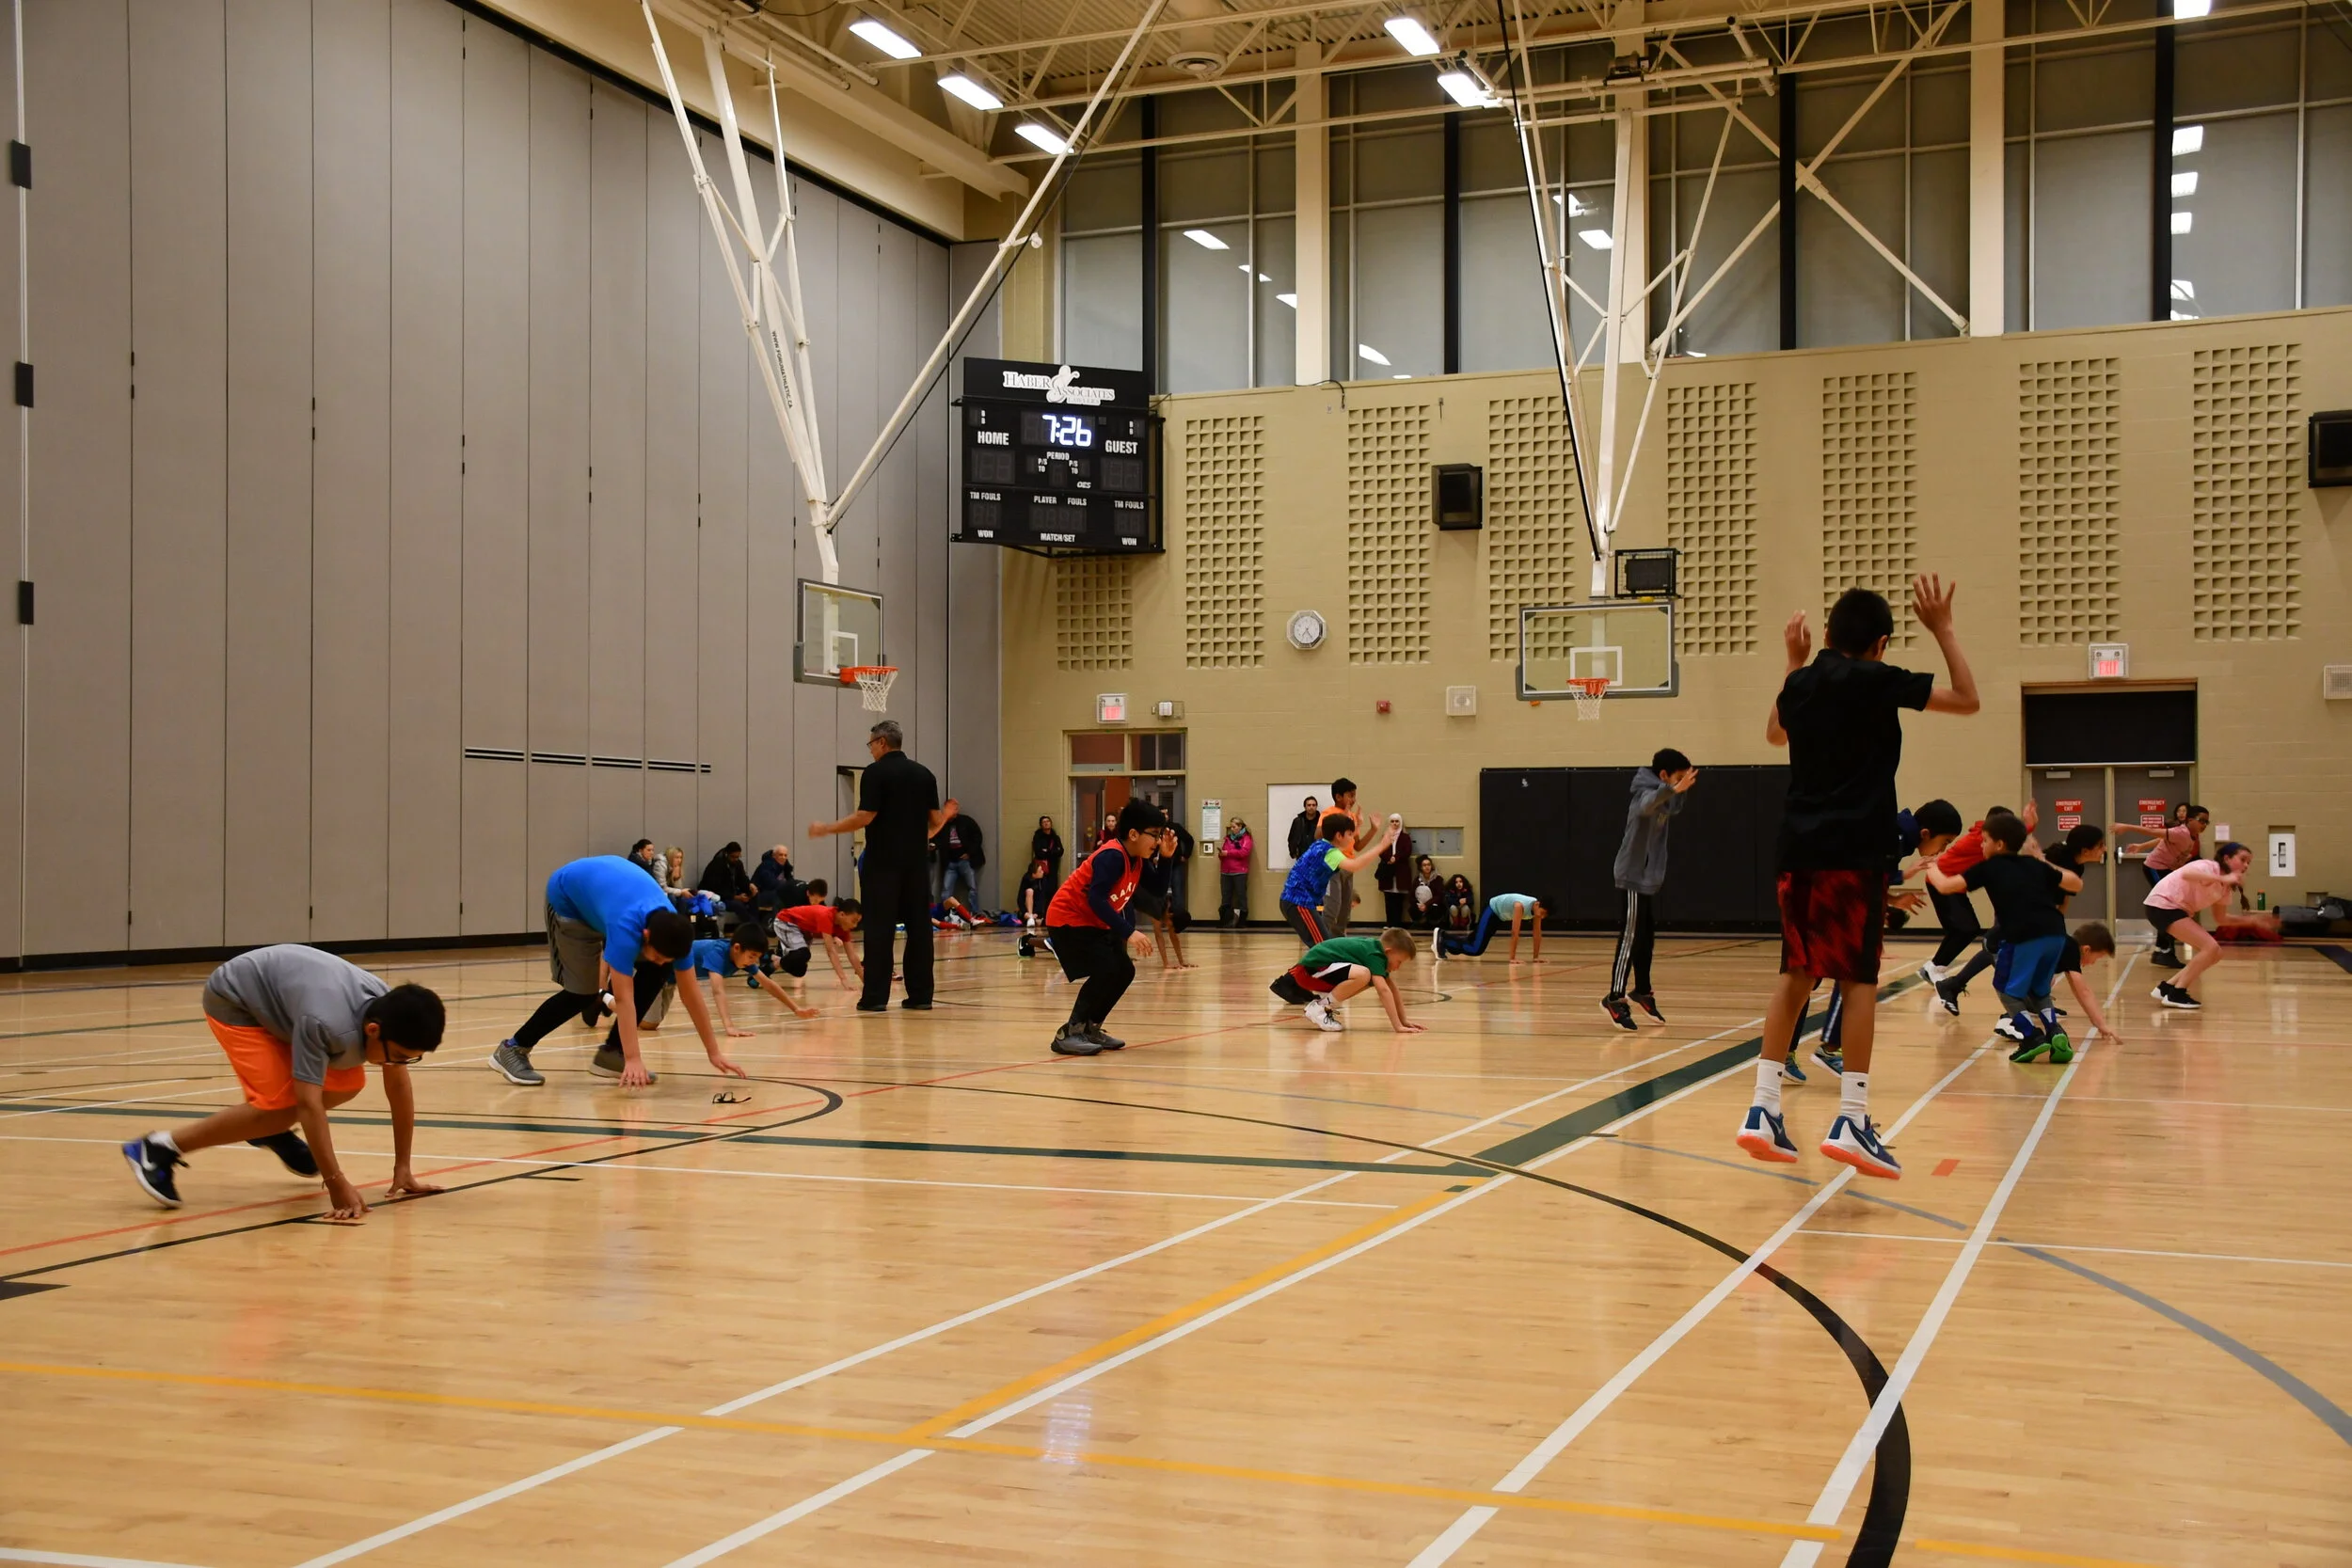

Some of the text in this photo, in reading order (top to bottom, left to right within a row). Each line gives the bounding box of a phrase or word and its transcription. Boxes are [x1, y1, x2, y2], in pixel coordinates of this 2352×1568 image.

[1005, 373, 1051, 388] HABER
[1056, 385, 1114, 399] ASSOCIATES
[1041, 414, 1092, 447] 7:26
[977, 431, 1009, 446] HOME
[1104, 439, 1138, 454] GUEST
[1046, 451, 1070, 461] PERIOD
[980, 492, 1001, 501] FOULS
[1033, 495, 1088, 507] PLAYER FOULS
[1124, 500, 1145, 510] FOULS
[977, 529, 994, 539] WON
[1040, 532, 1076, 543] MATCH/SET
